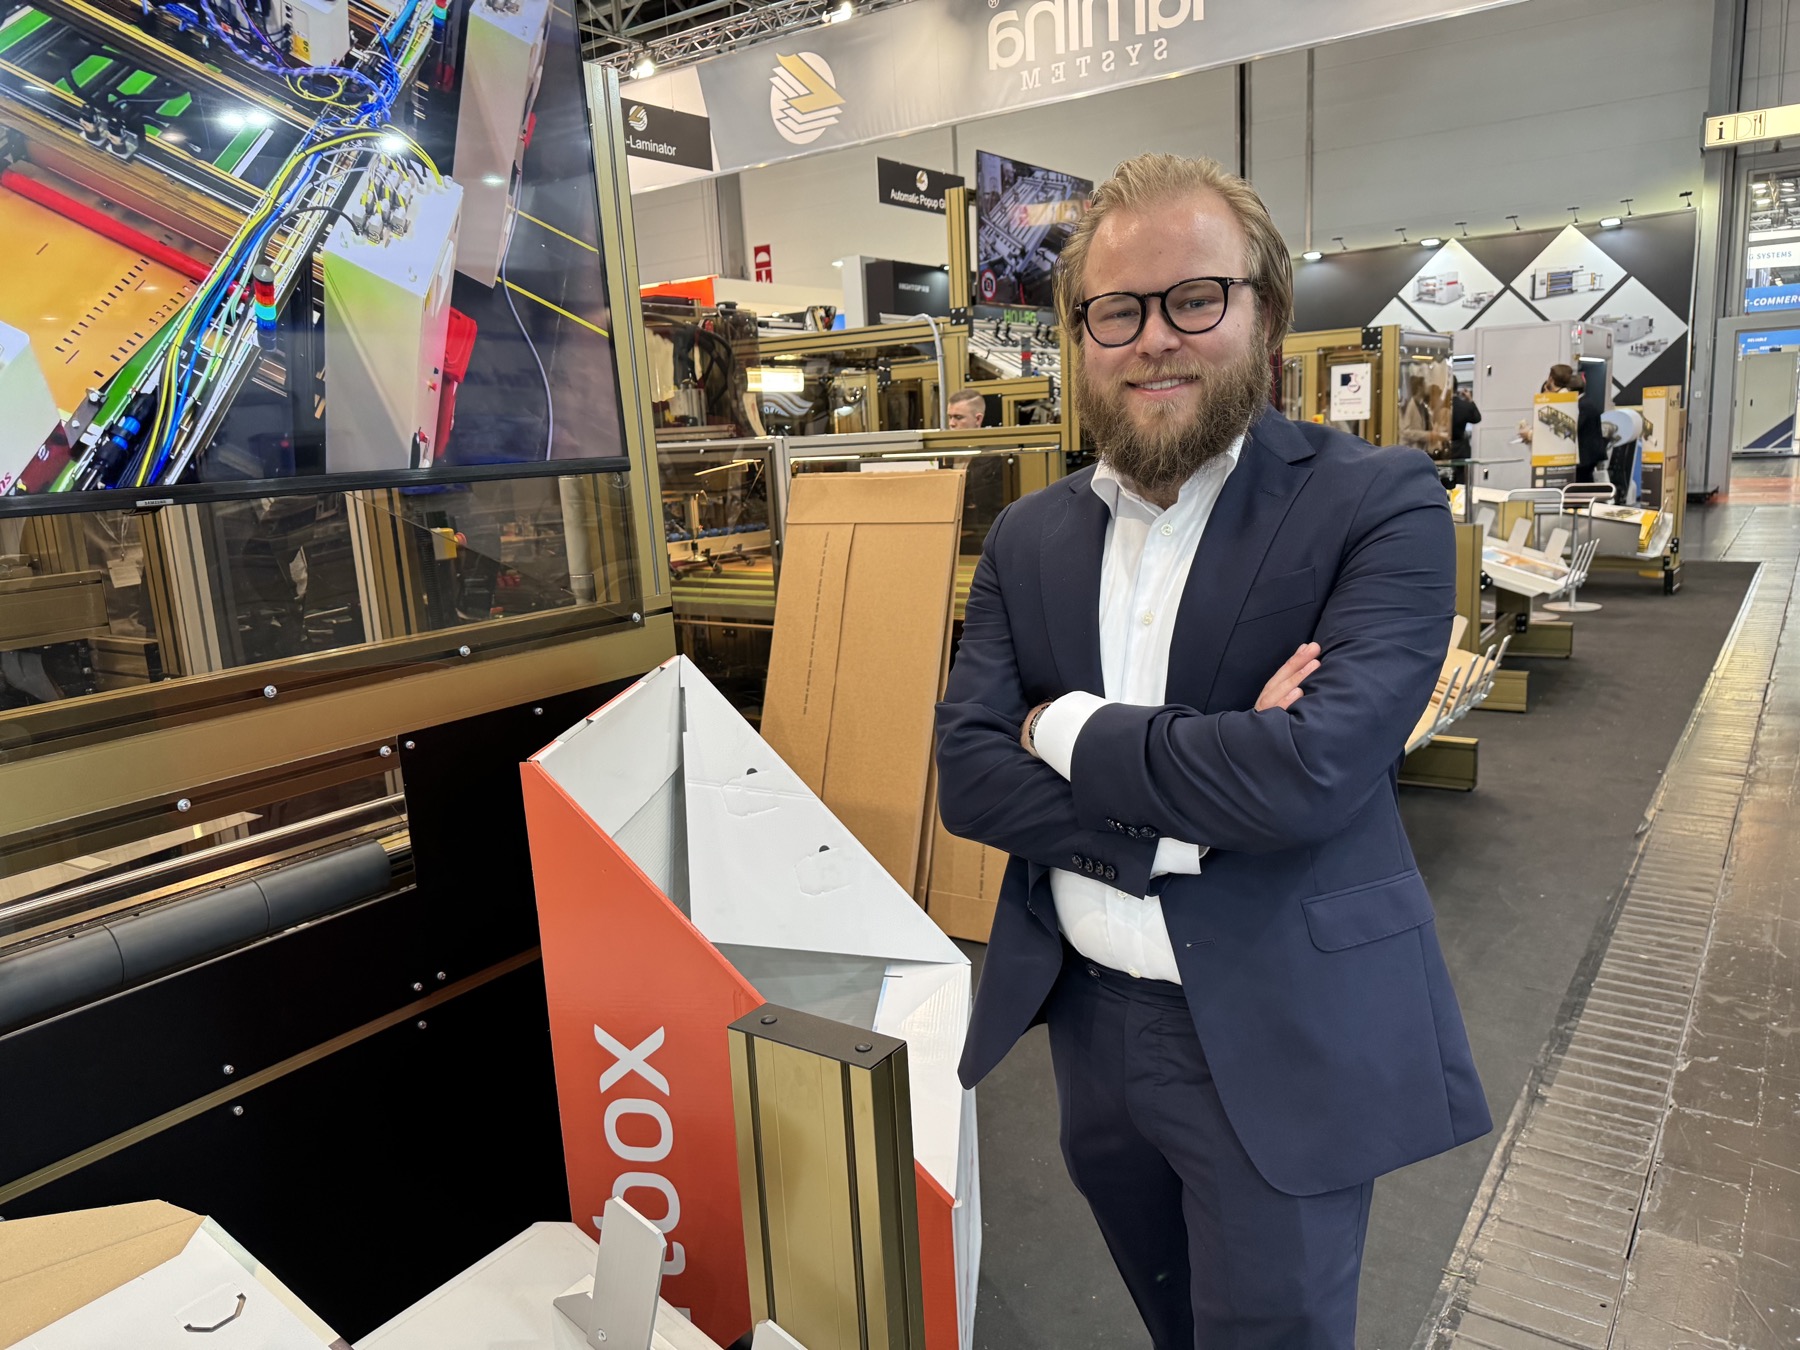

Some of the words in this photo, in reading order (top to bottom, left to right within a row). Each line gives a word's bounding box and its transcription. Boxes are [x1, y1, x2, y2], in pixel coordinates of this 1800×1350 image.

[890, 188, 919, 205] Automatic
[919, 194, 939, 210] Popup
[1756, 250, 1793, 260] SYSTEMS
